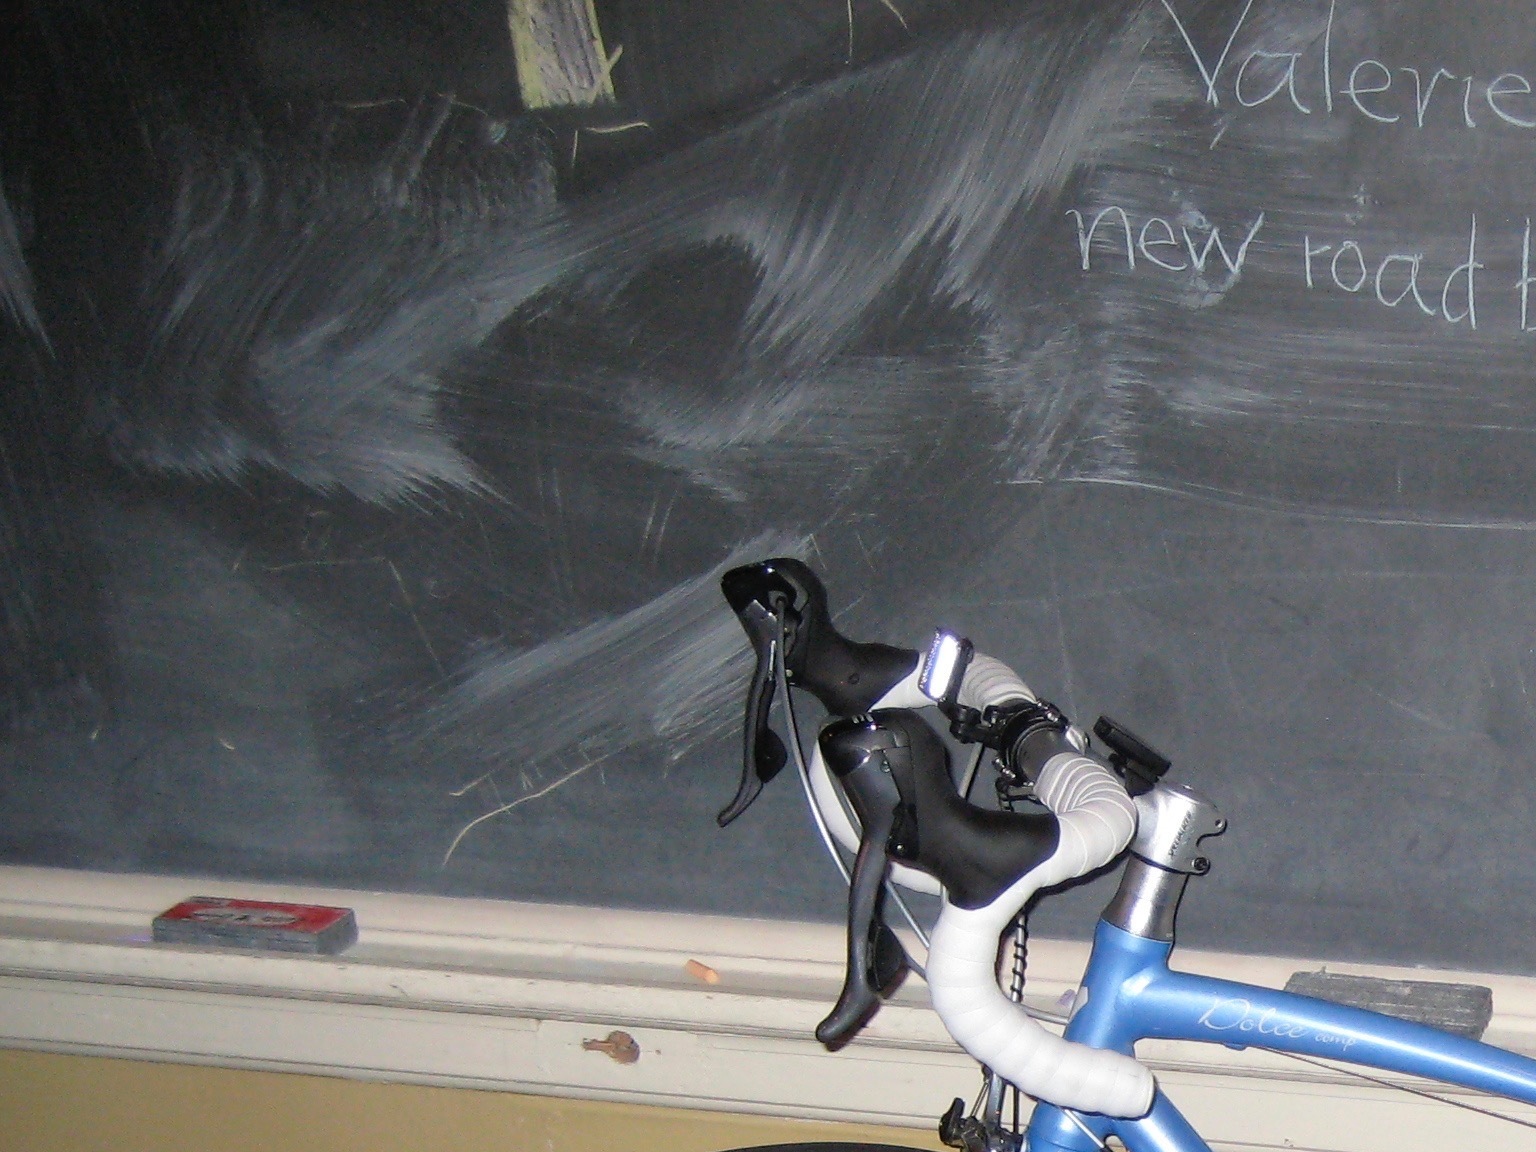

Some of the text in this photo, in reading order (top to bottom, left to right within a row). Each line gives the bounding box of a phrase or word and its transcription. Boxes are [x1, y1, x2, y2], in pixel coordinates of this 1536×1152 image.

[1066, 205, 1264, 271] new
[1304, 213, 1484, 330] road
[1198, 997, 1309, 1038] Dolce
